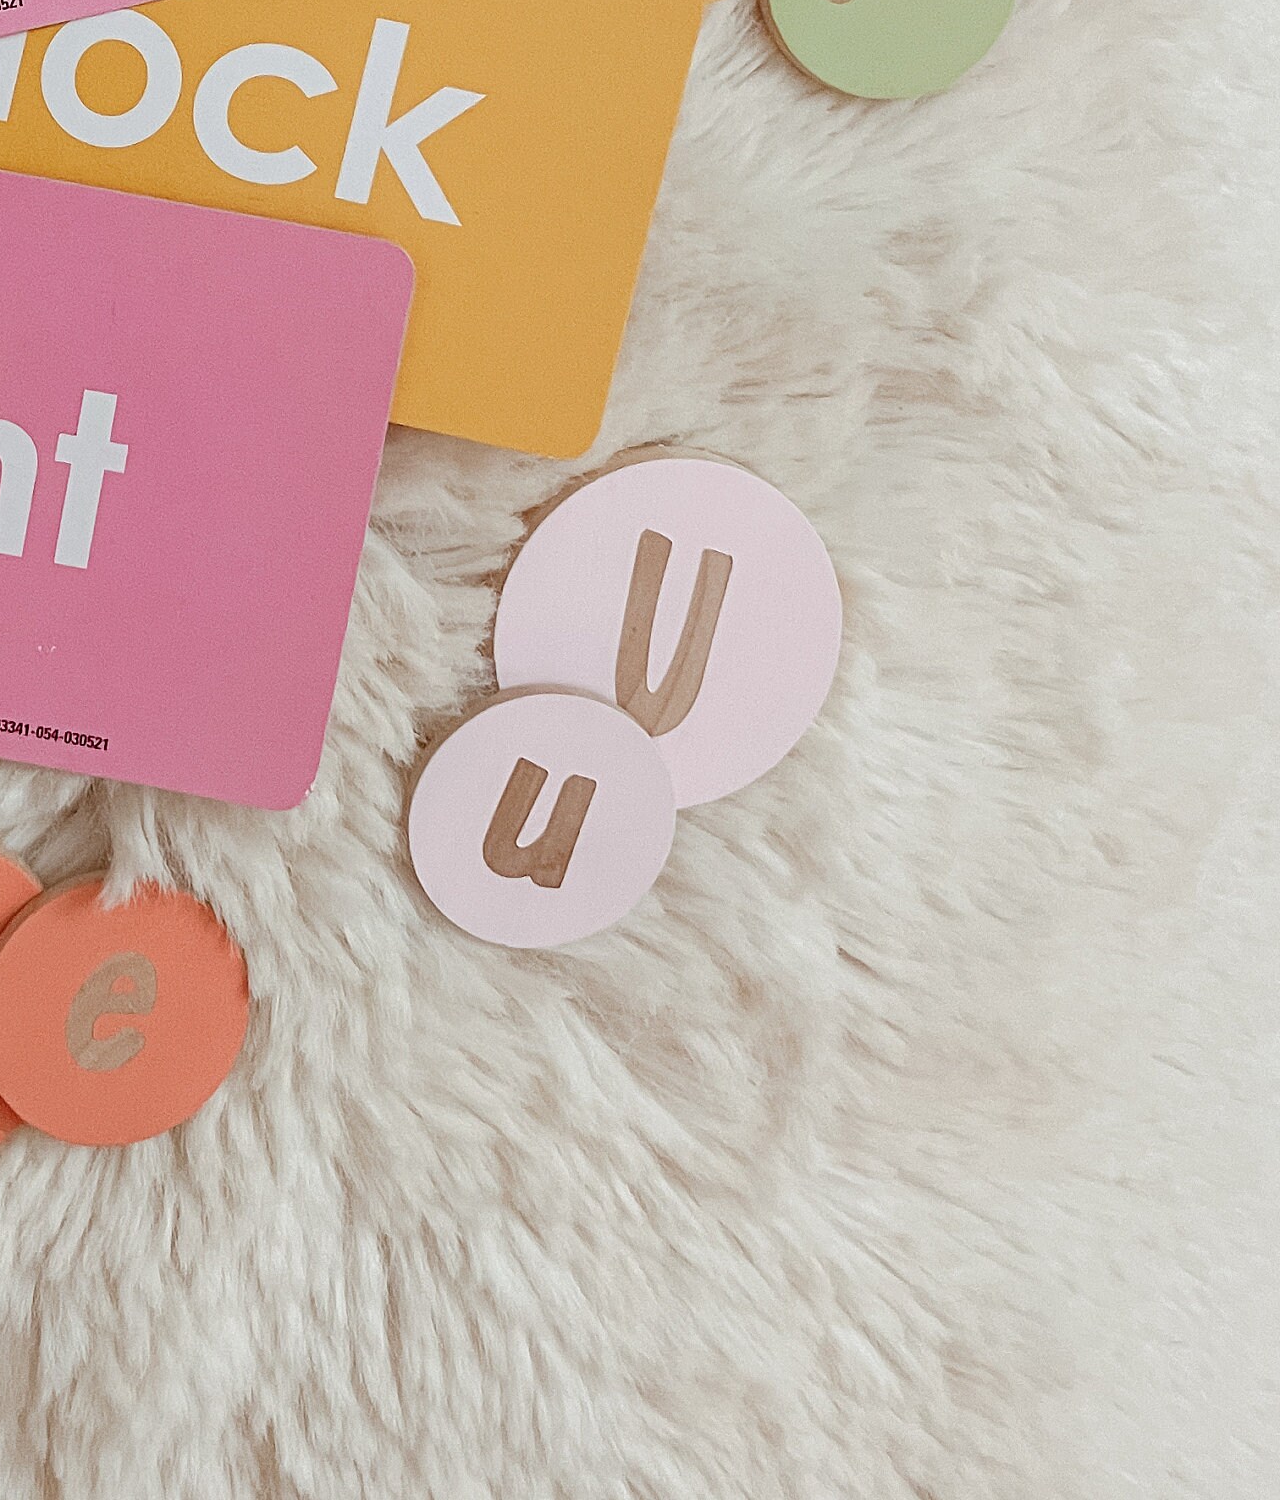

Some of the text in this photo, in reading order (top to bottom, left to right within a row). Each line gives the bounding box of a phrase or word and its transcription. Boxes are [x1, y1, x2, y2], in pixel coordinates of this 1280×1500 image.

[615, 528, 734, 738] U
[483, 757, 597, 889] u
[65, 951, 158, 1073] e
